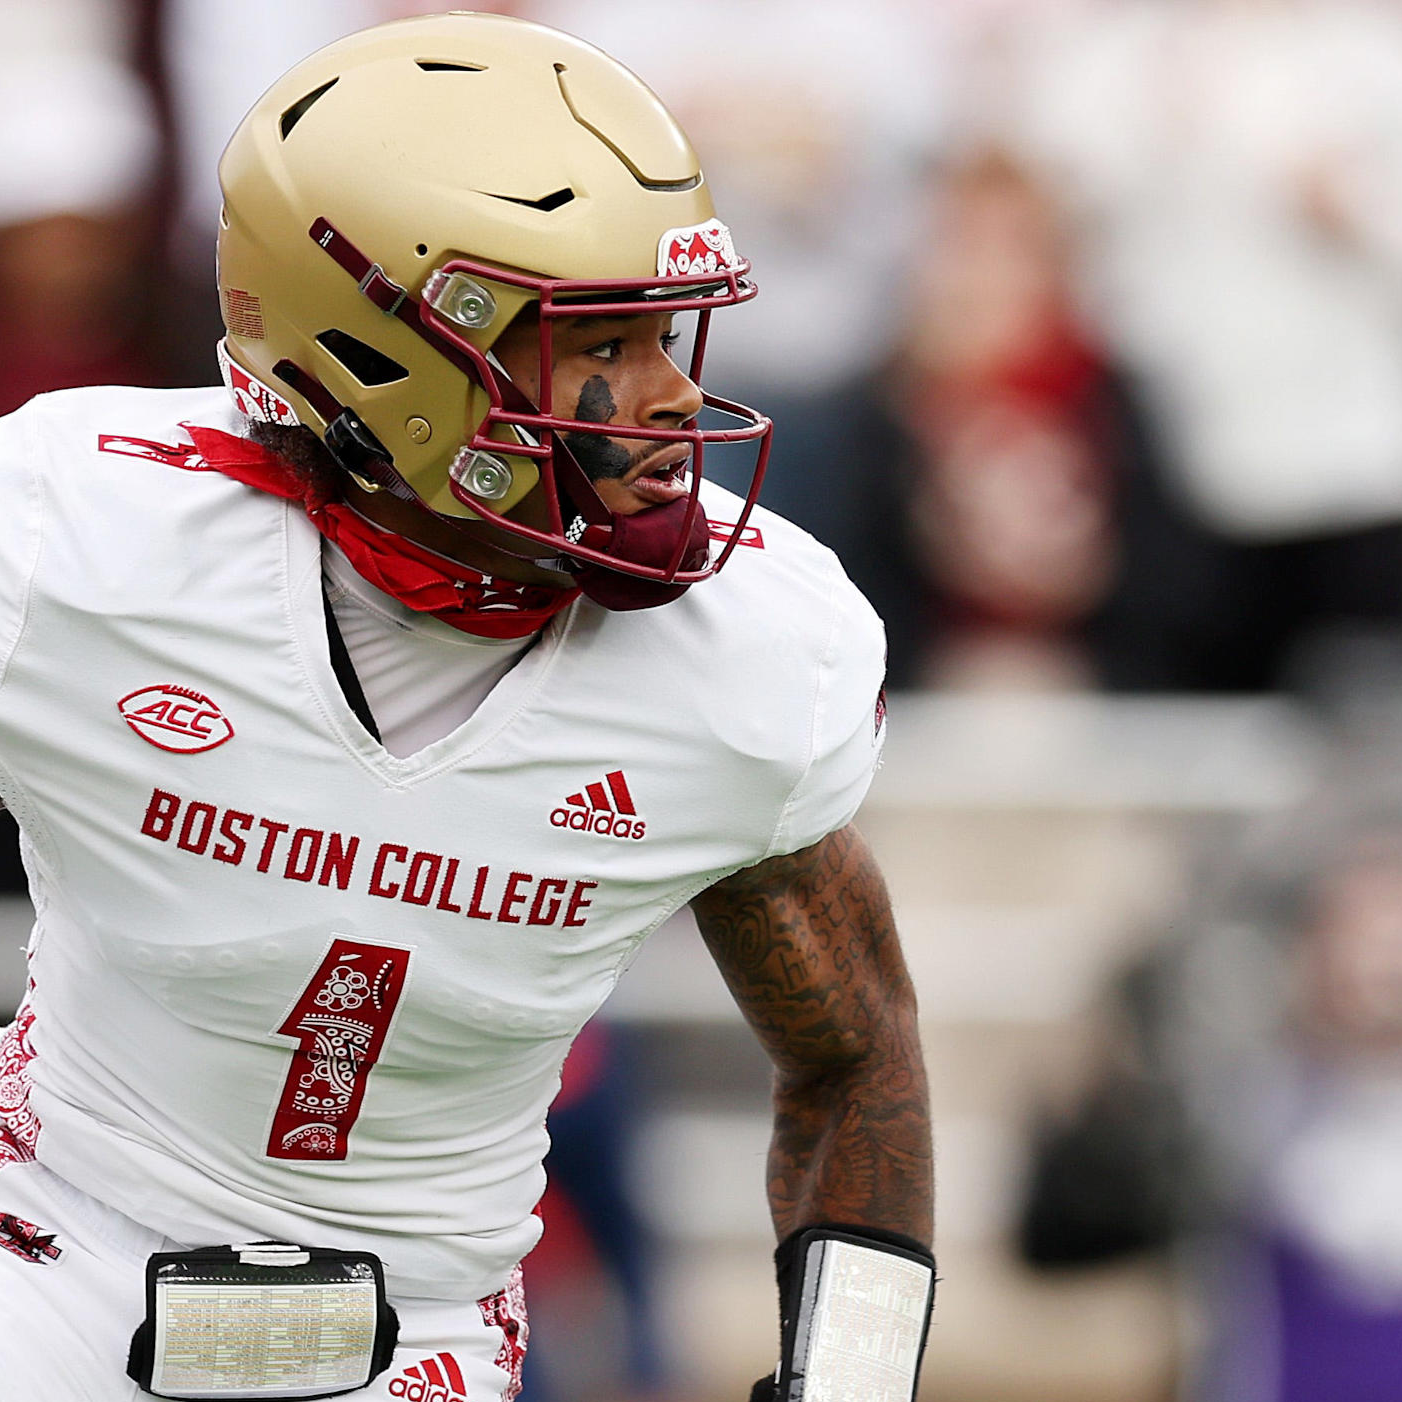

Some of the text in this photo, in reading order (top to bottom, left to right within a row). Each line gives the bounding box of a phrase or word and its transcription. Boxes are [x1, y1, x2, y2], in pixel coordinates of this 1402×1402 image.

[133, 700, 221, 734] ACC
[141, 788, 598, 927] BOSTON COLLEGE
[549, 807, 646, 840] adidas
[266, 936, 412, 1162] 1
